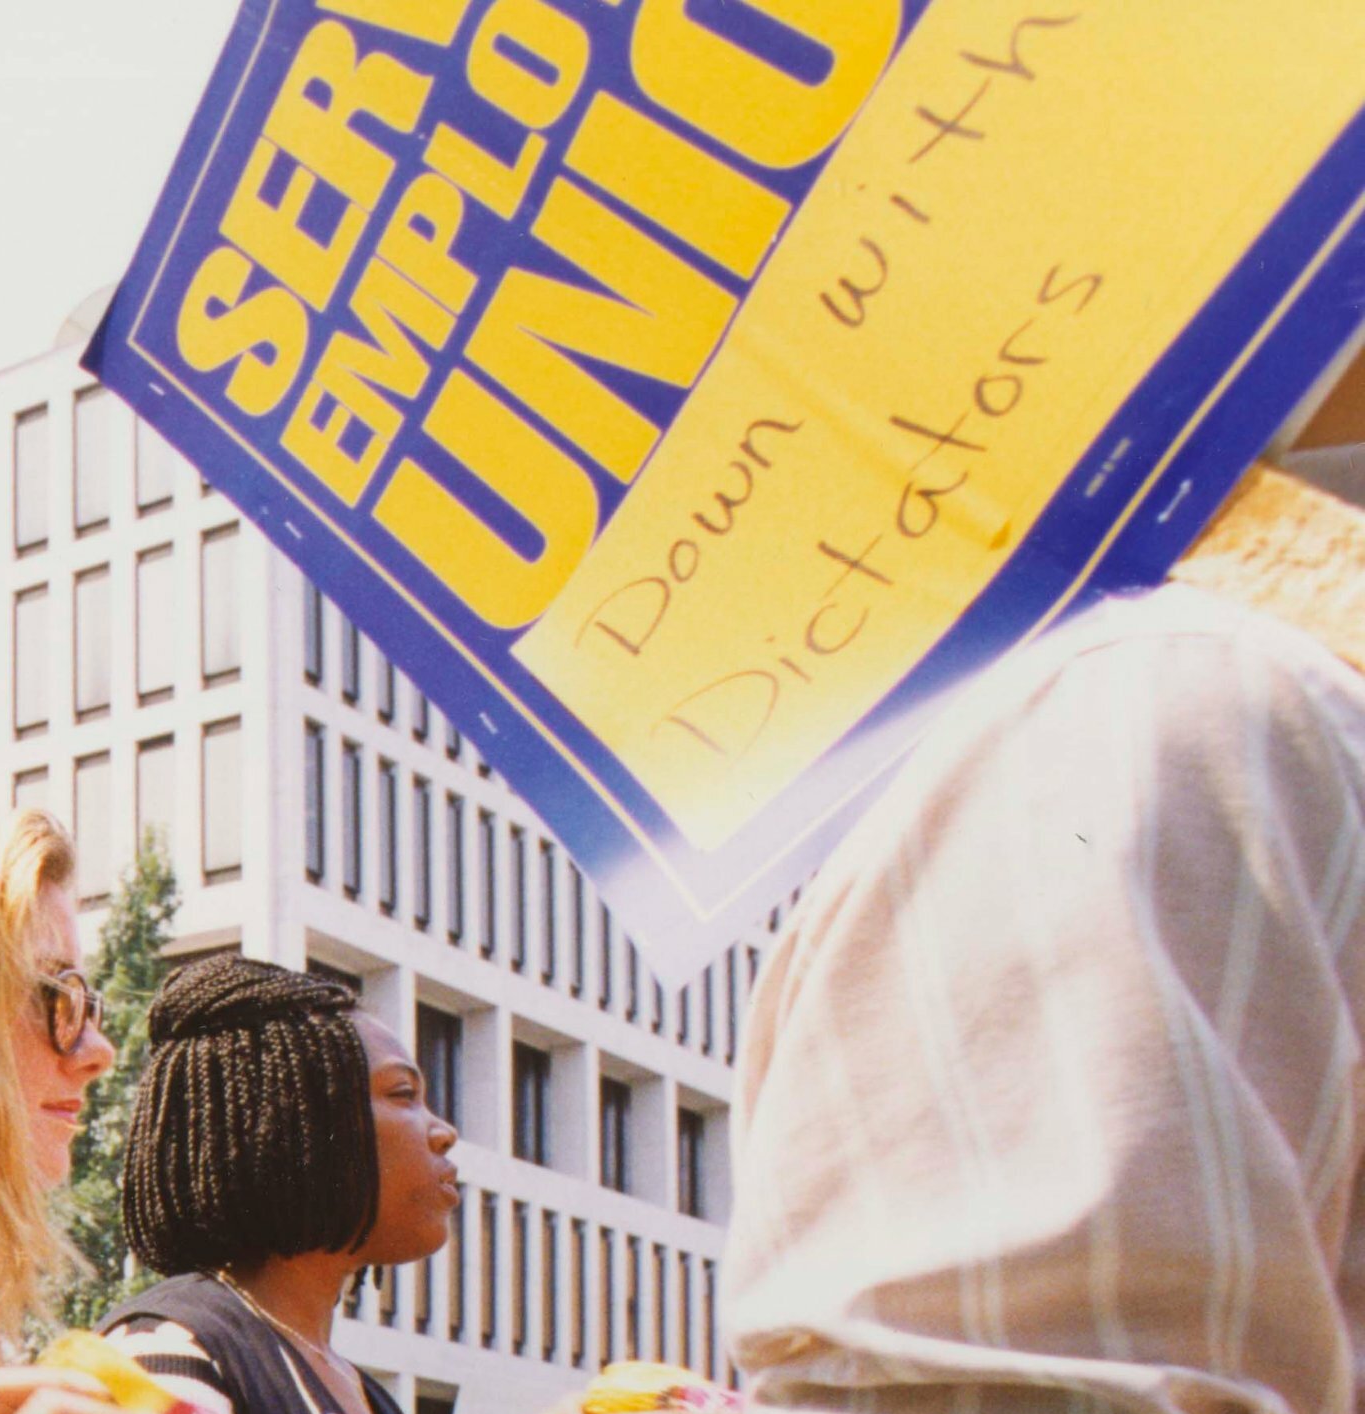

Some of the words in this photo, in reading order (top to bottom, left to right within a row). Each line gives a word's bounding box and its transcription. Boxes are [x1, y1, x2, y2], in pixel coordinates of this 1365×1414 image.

[279, 0, 599, 509] EMPLO
[575, 417, 806, 657] Down
[820, 14, 1081, 329] with
[648, 262, 1104, 774] Dictators
